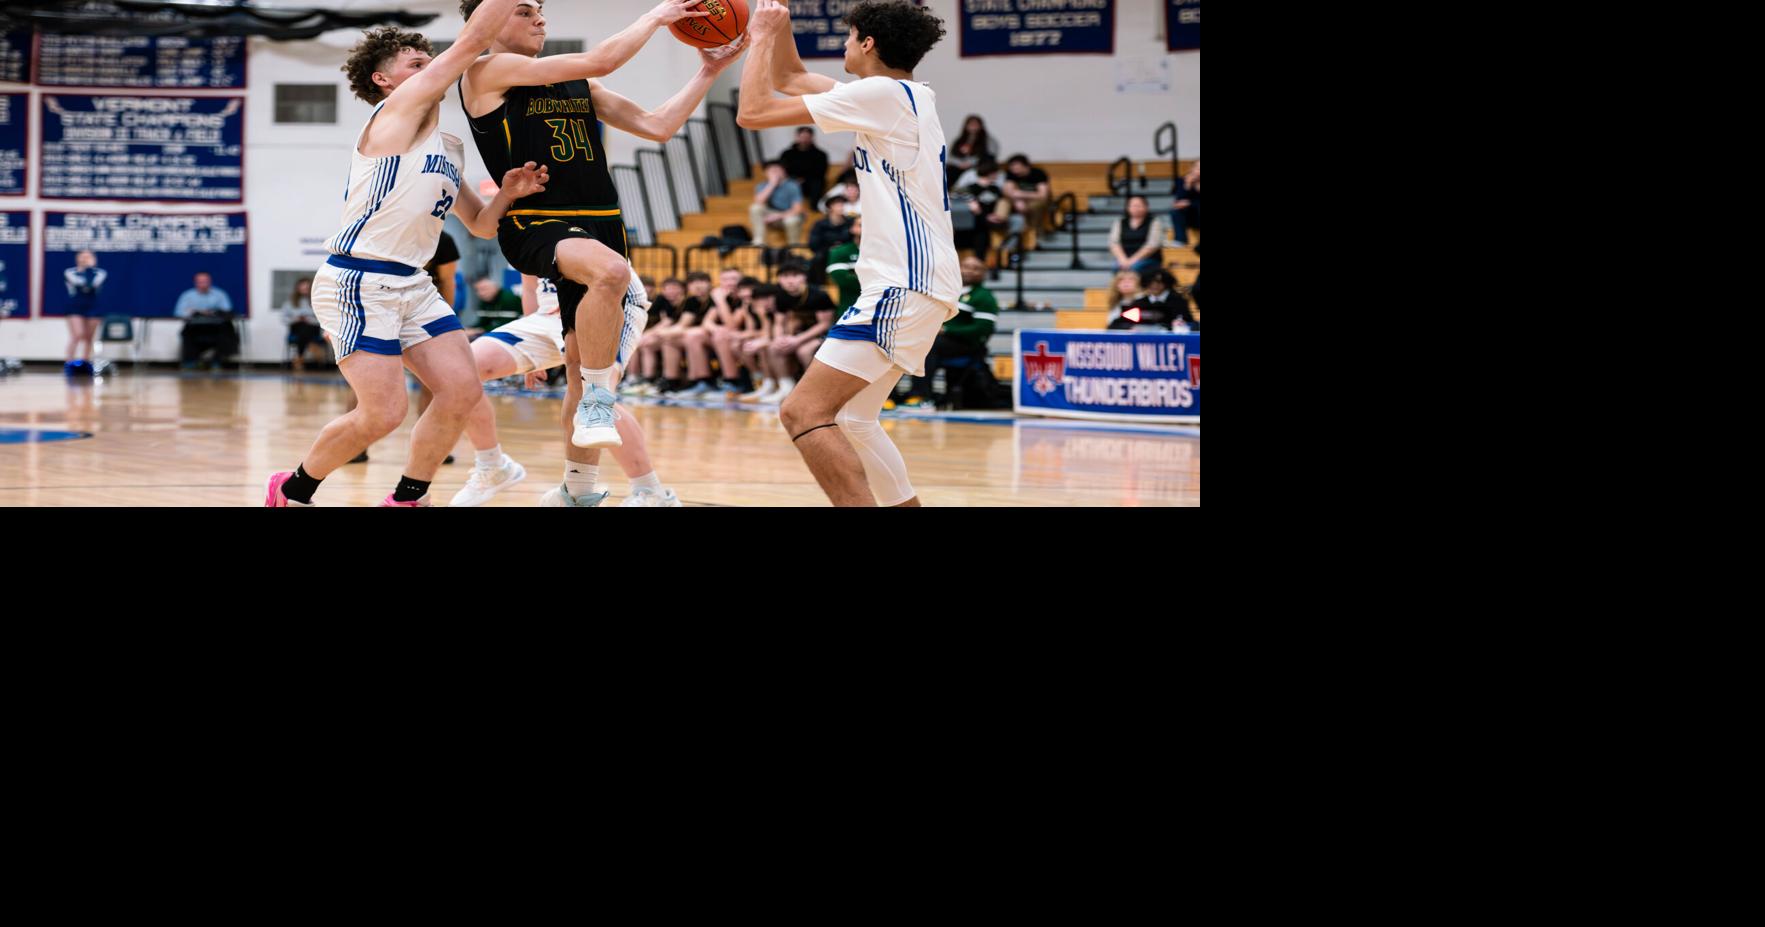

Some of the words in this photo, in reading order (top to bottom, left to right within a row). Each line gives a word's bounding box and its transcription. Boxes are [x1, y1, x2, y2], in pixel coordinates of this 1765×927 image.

[792, 19, 829, 34] OYS
[971, 14, 1021, 30] BOYS
[1024, 12, 1101, 28] SOCCER
[1009, 30, 1063, 46] 1977
[92, 97, 195, 112] VERMONT
[60, 111, 118, 127] STATE
[120, 112, 225, 129] CHAMPIONS
[544, 118, 594, 162] 34
[63, 213, 121, 229] STATE
[124, 213, 229, 230] CHAMPIONS
[1066, 341, 1134, 371] MISSISQUOI
[1136, 342, 1186, 371] VALLEY
[1064, 375, 1193, 408] THUNDERBIRDS
